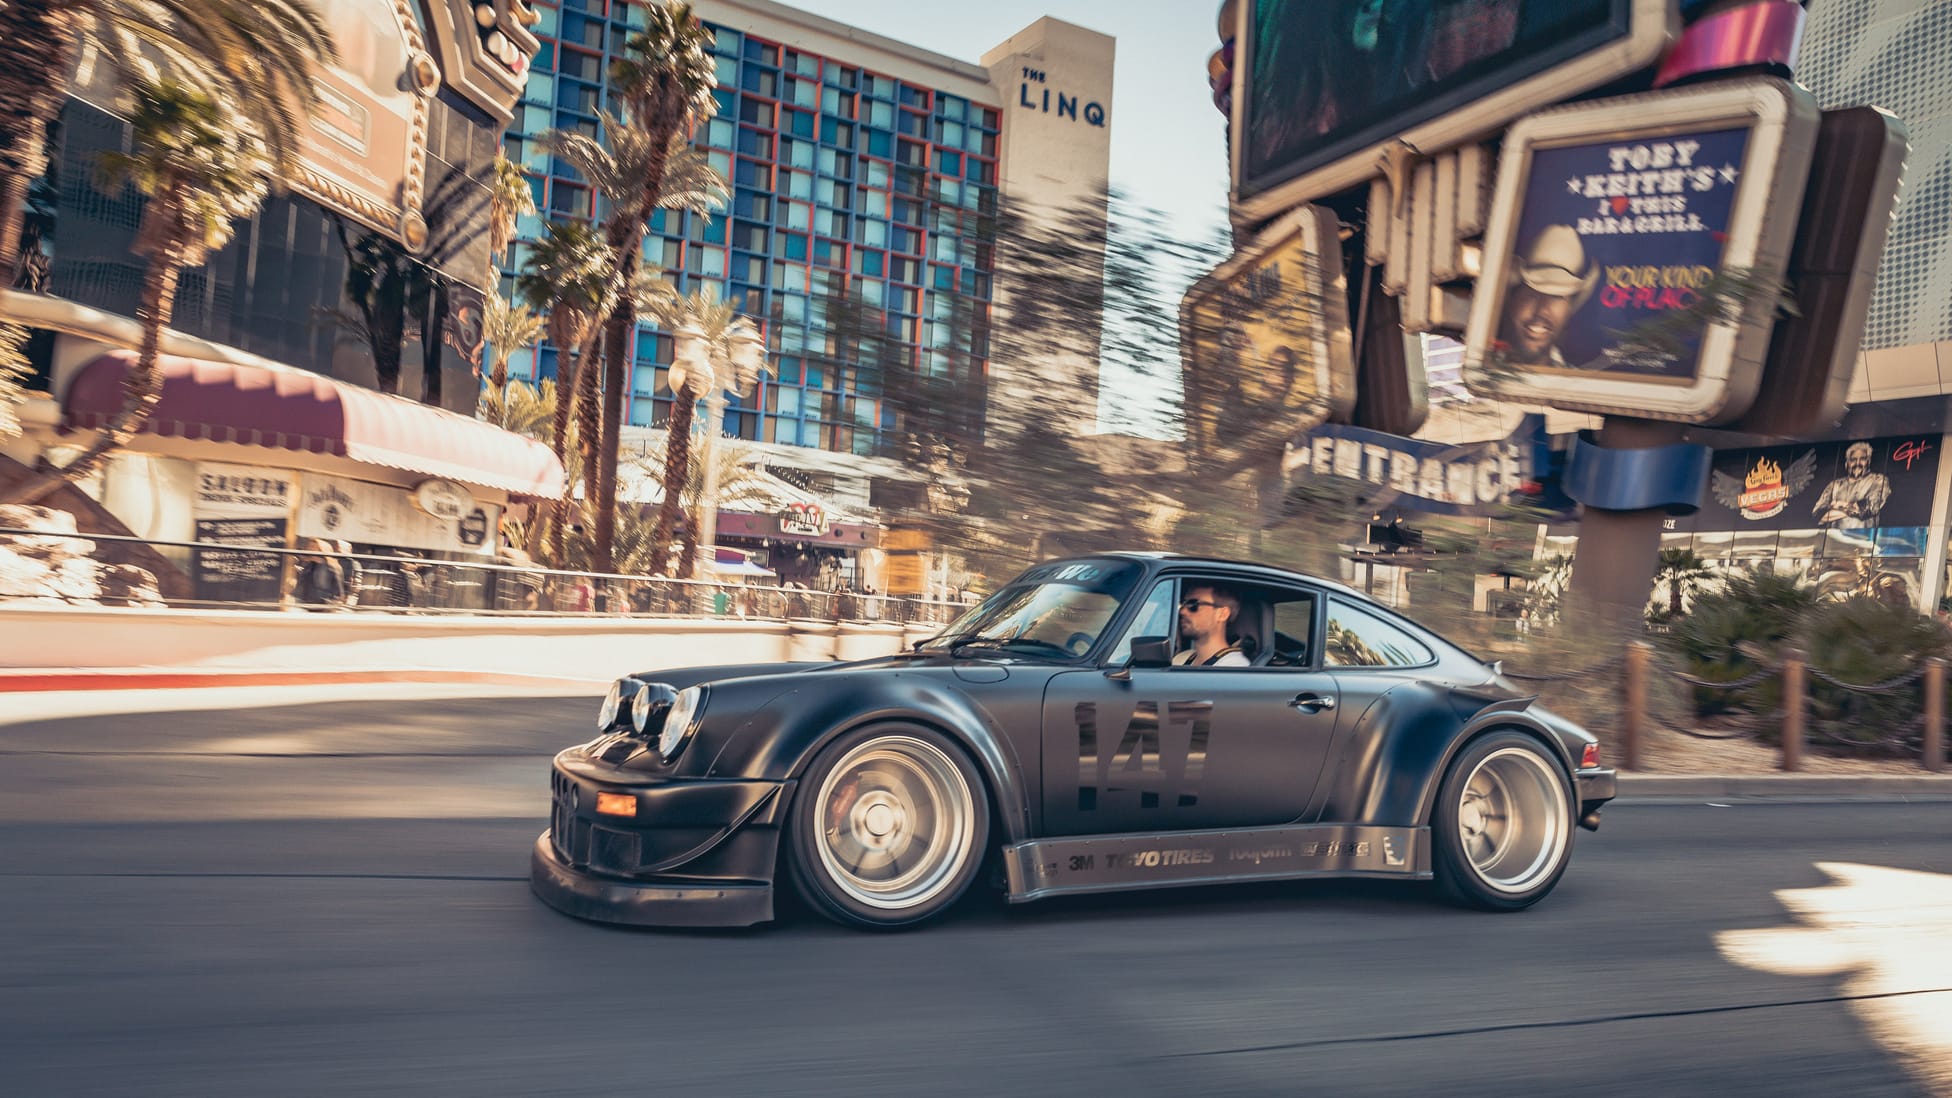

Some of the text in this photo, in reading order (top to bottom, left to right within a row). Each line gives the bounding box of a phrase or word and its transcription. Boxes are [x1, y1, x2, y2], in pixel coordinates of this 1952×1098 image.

[1022, 66, 1046, 83] THE
[1020, 82, 1105, 128] LINQ
[1608, 140, 1701, 171] TOBY
[1583, 165, 1716, 198] KEITH'S
[1630, 195, 1687, 214] THIS
[1604, 264, 1714, 289] YOUR KIND
[1600, 285, 1704, 310] OF PLAC
[1311, 437, 1522, 505] ENTRANCE
[1740, 485, 1787, 508] VEGAS
[1074, 701, 1214, 811] 147
[1069, 855, 1095, 872] 3M
[1161, 849, 1214, 866] TIRES
